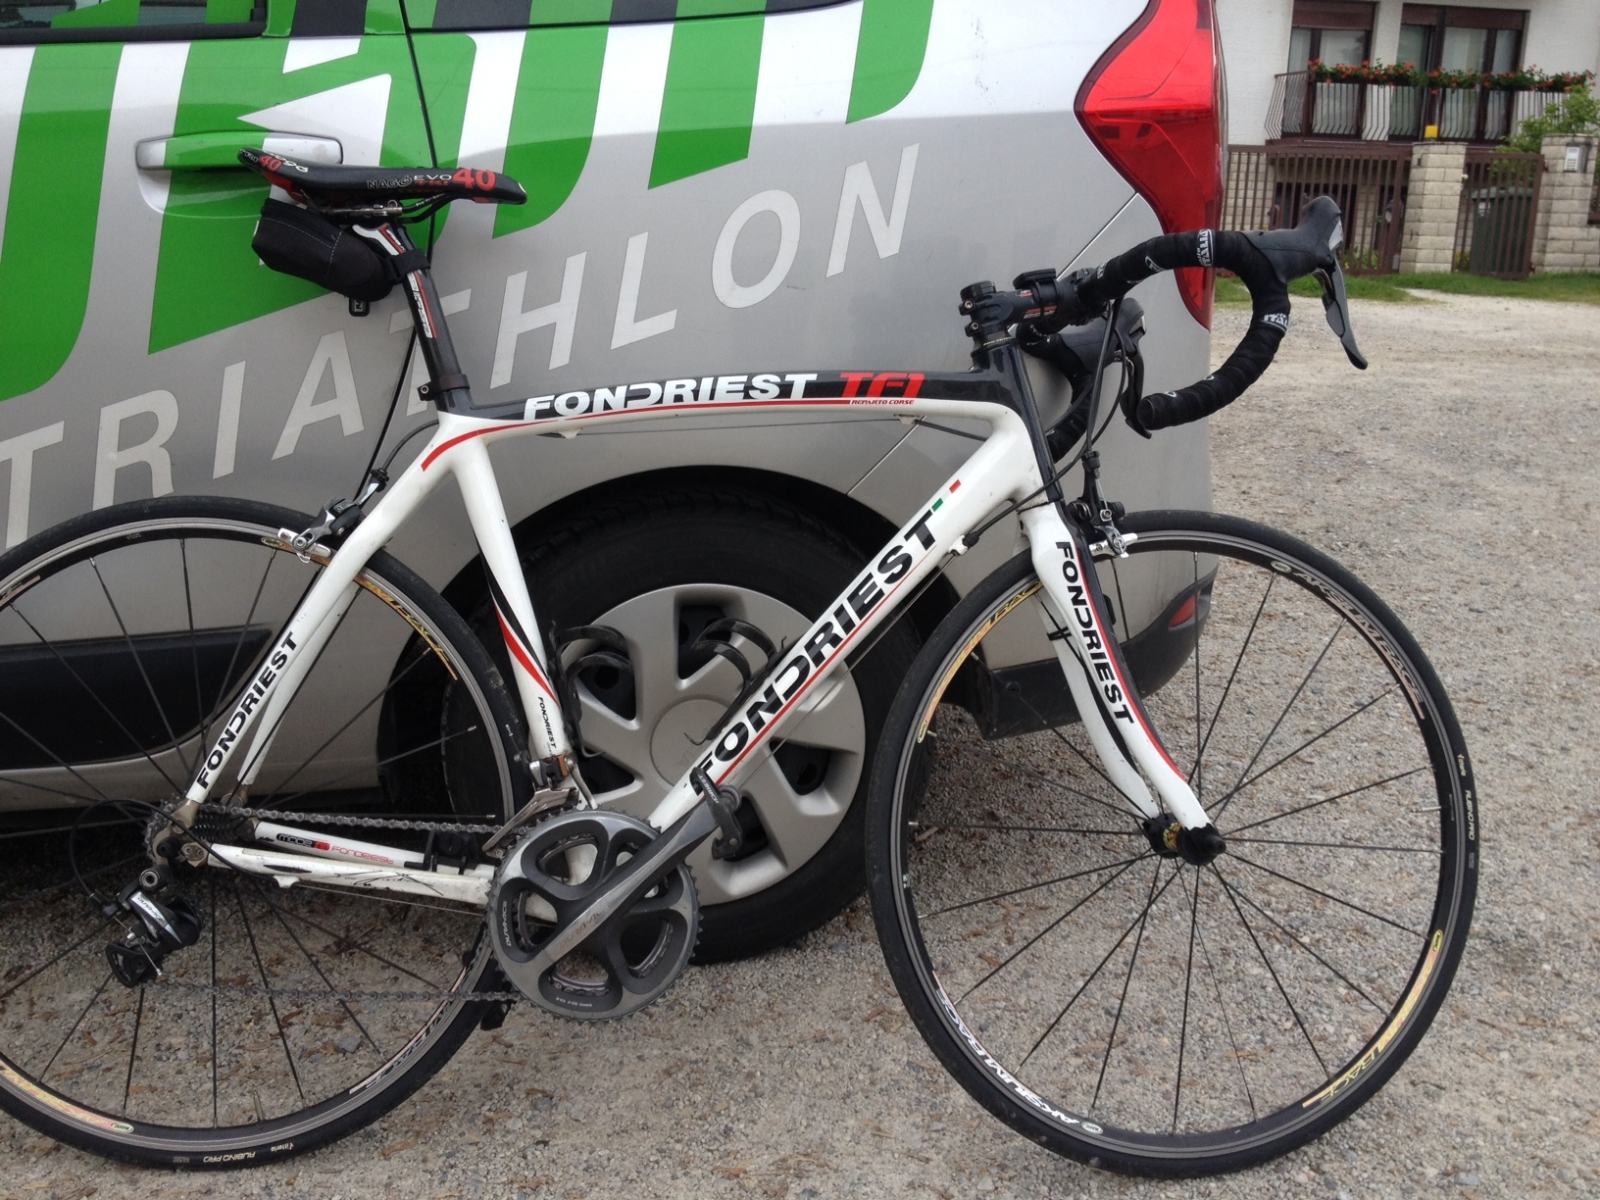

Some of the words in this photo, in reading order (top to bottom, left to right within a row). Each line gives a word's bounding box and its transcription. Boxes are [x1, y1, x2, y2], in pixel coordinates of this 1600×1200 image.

[452, 167, 497, 192] 40
[523, 372, 818, 421] FONDRIEST
[1055, 541, 1135, 724] FONDRIEST
[196, 630, 297, 790] FONDRIEST
